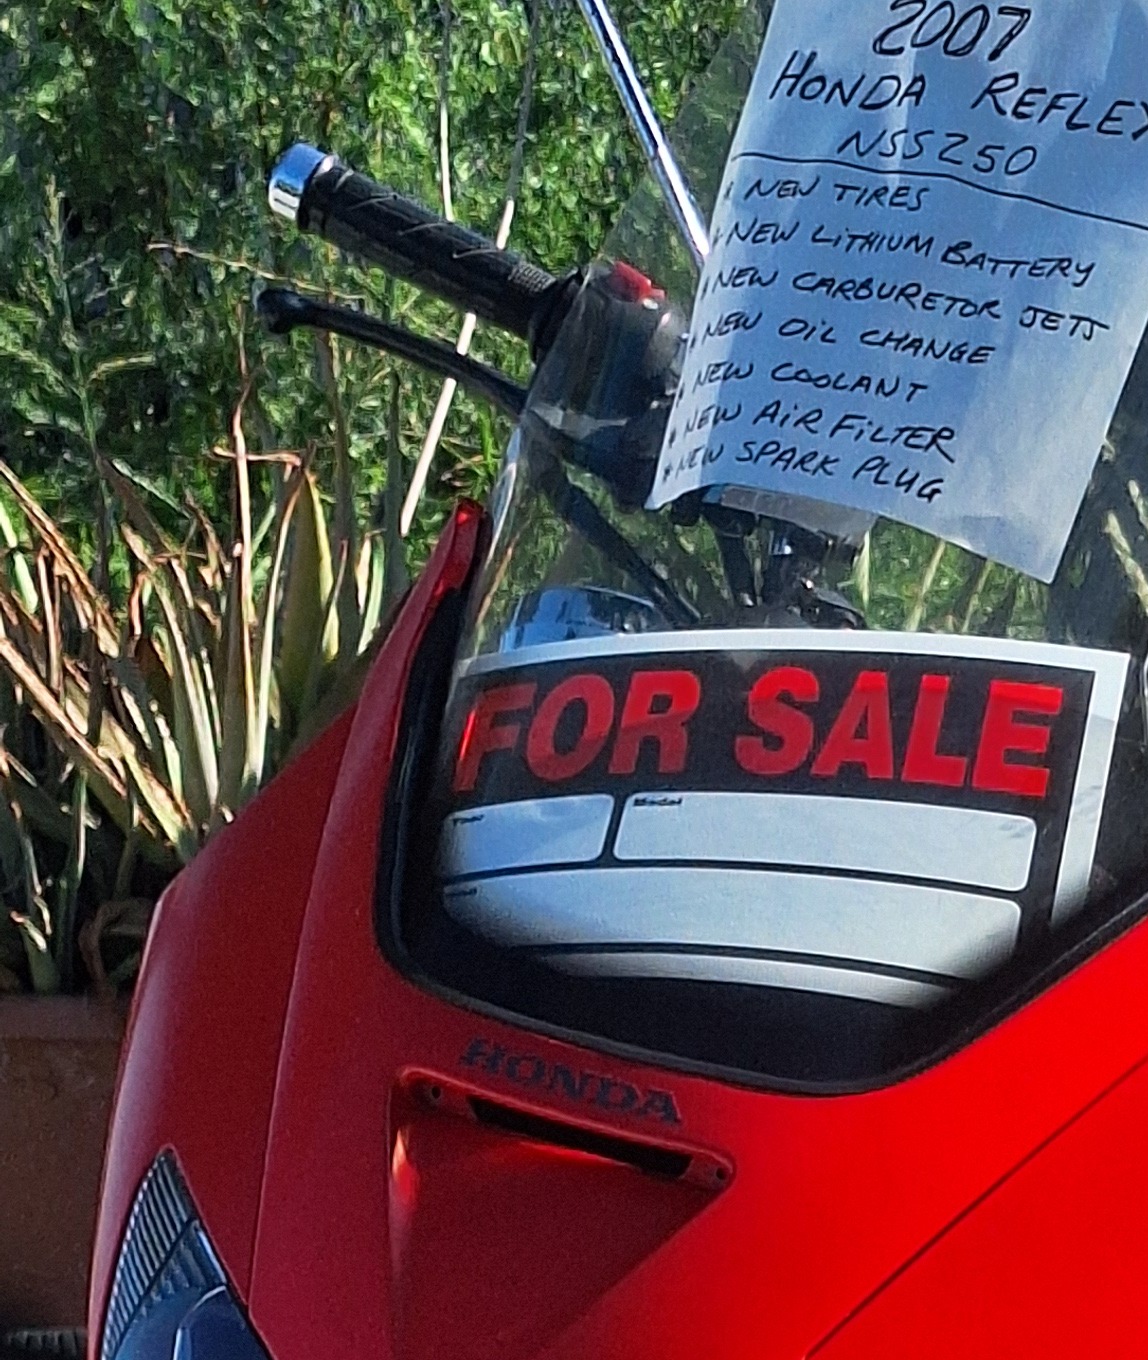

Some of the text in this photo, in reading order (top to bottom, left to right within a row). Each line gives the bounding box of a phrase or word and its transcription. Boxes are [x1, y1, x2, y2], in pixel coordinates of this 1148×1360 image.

[873, 0, 1031, 61] 2007
[769, 50, 926, 112] HONDA
[837, 129, 1038, 176] NSS250
[744, 175, 930, 212] NEW TIRES
[725, 217, 800, 246] NEW
[941, 241, 1095, 287] BATTERY
[712, 266, 779, 294] NEW
[792, 271, 1002, 320] CARBURETOR
[702, 311, 763, 345] NEW
[860, 330, 996, 364] CHANGE
[693, 361, 929, 402] NEW COOLANT
[684, 403, 742, 438] NEW
[735, 441, 840, 477] SPARK
[852, 456, 945, 503] PLUG
[453, 670, 701, 793] FOR
[733, 666, 1064, 798] SALE
[461, 1037, 682, 1127] HONDA
